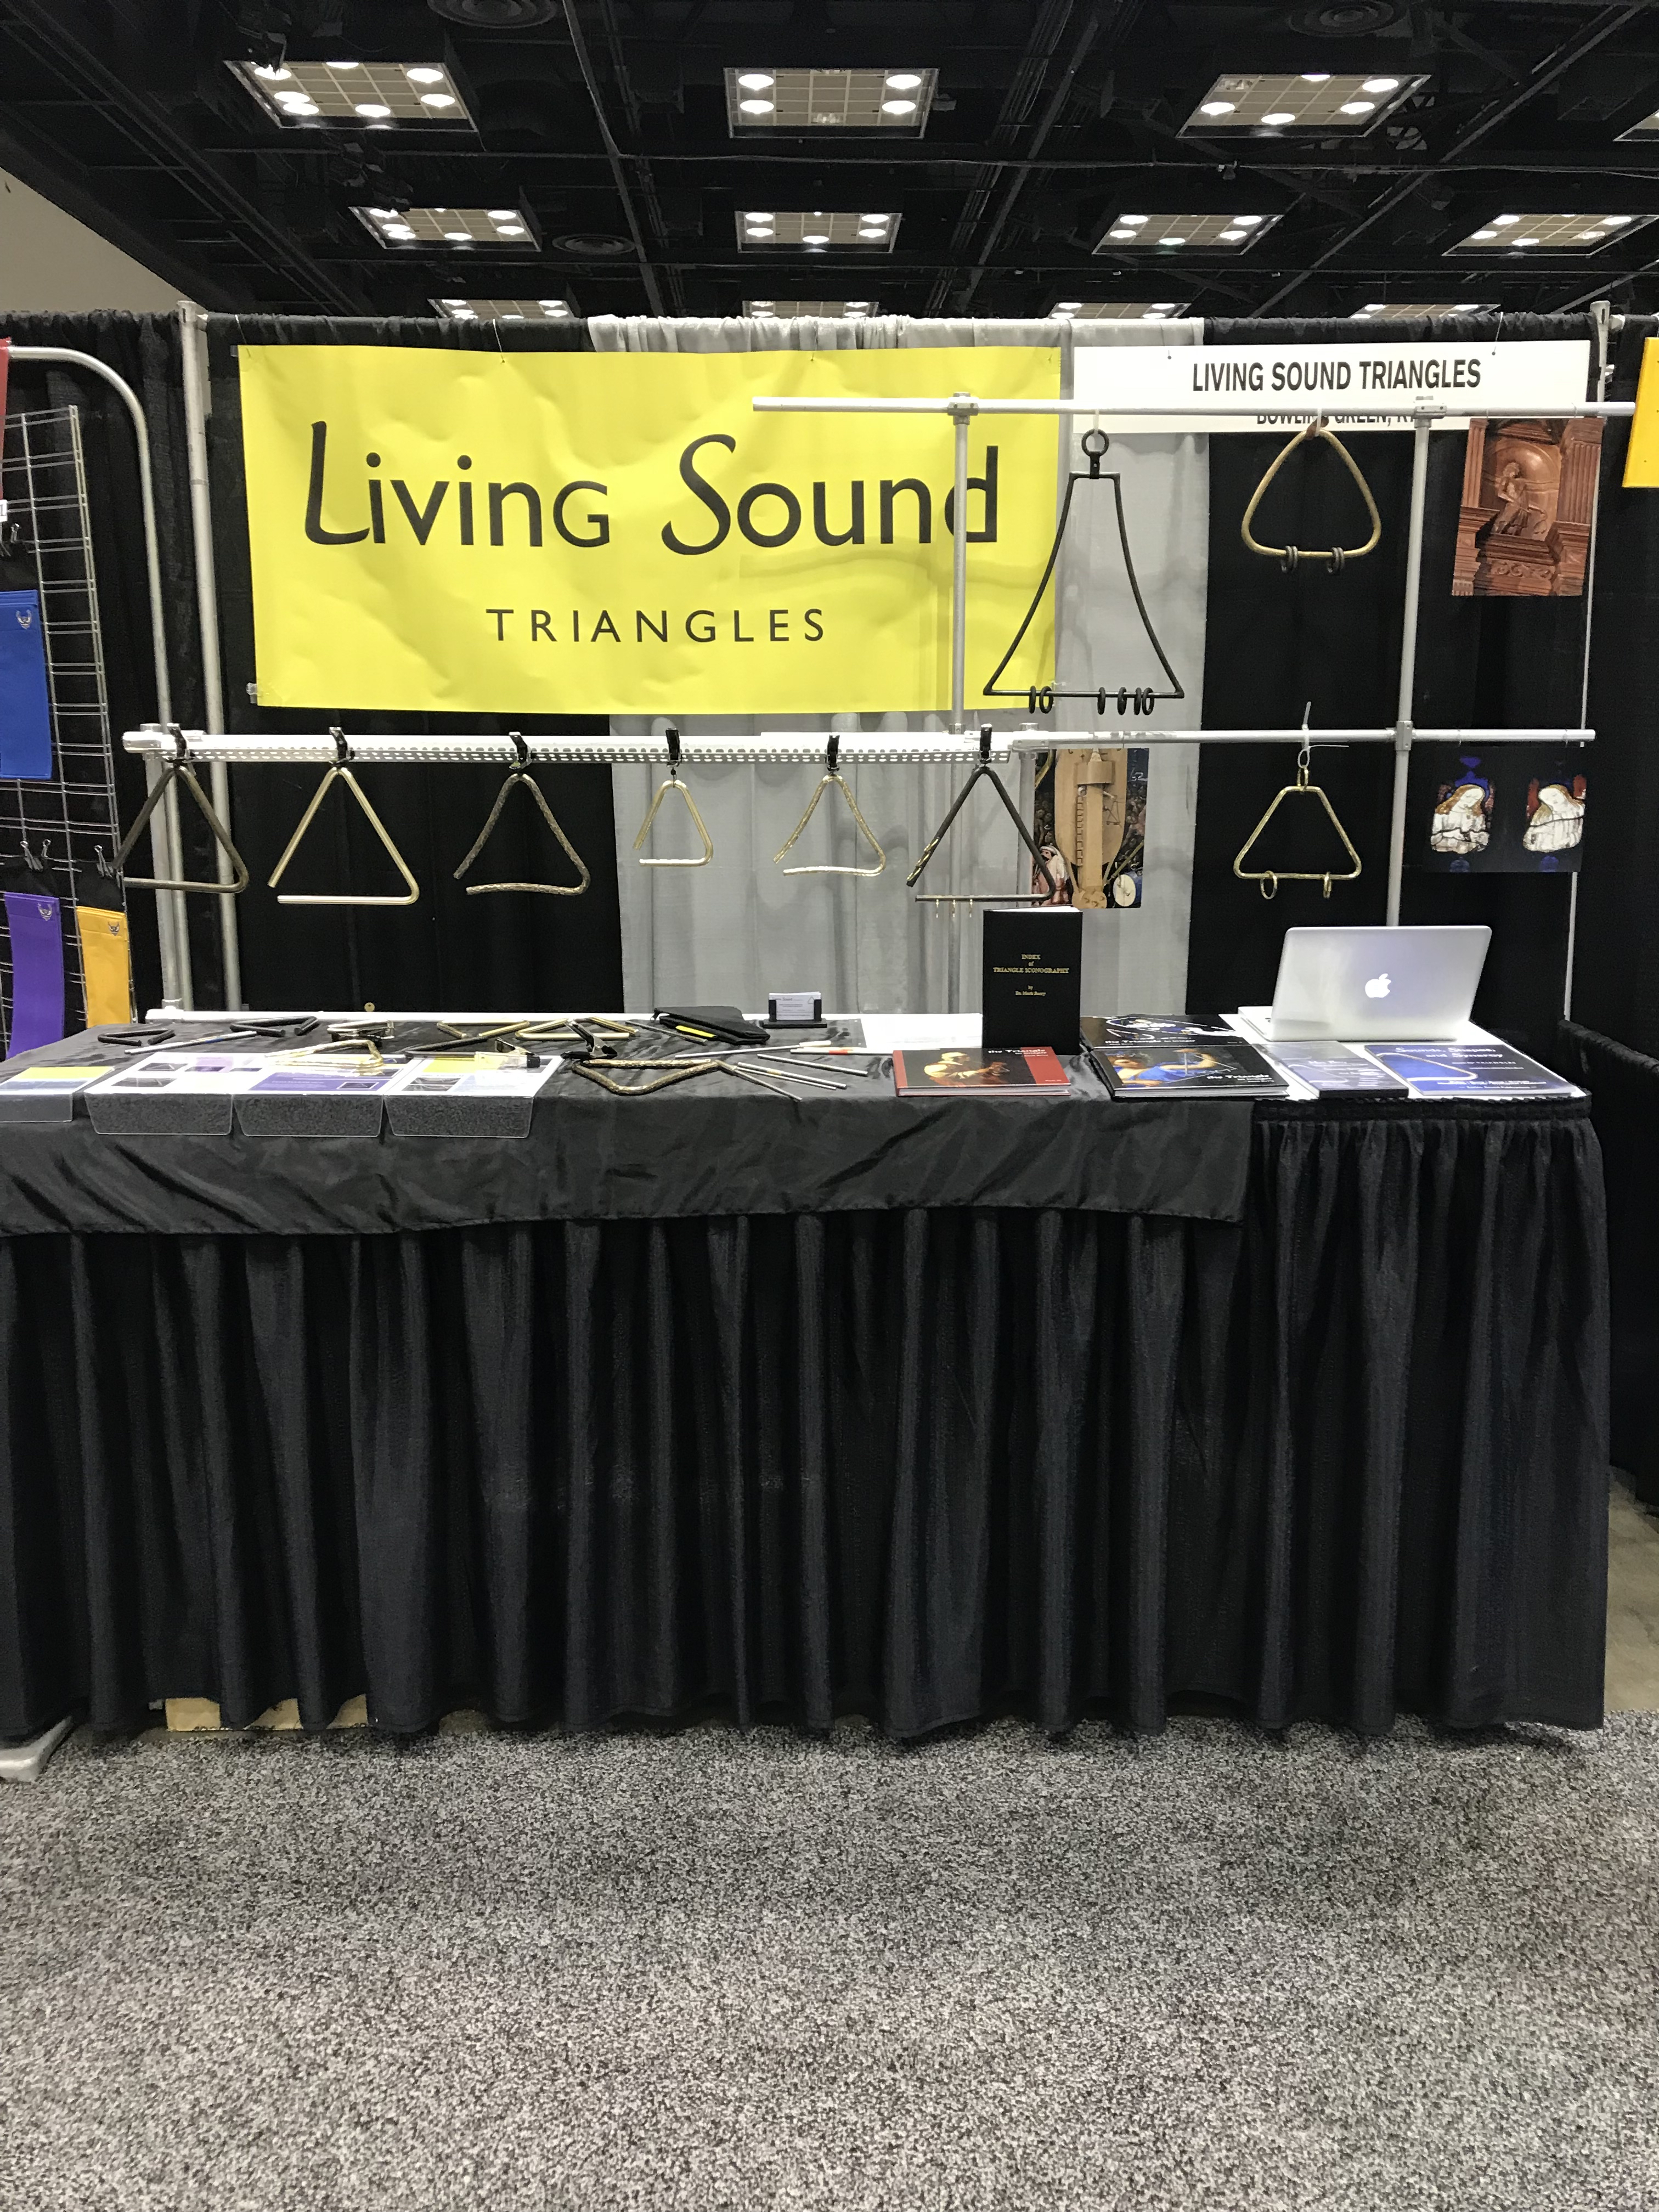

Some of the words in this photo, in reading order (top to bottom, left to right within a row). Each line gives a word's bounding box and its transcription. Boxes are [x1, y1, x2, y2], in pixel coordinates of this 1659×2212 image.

[1193, 363, 1263, 392] LIVING
[1272, 362, 1351, 391] SOUND
[1358, 359, 1481, 390] TRIANGLES
[662, 434, 999, 556] Sound
[486, 608, 824, 643] TRIANGLES
